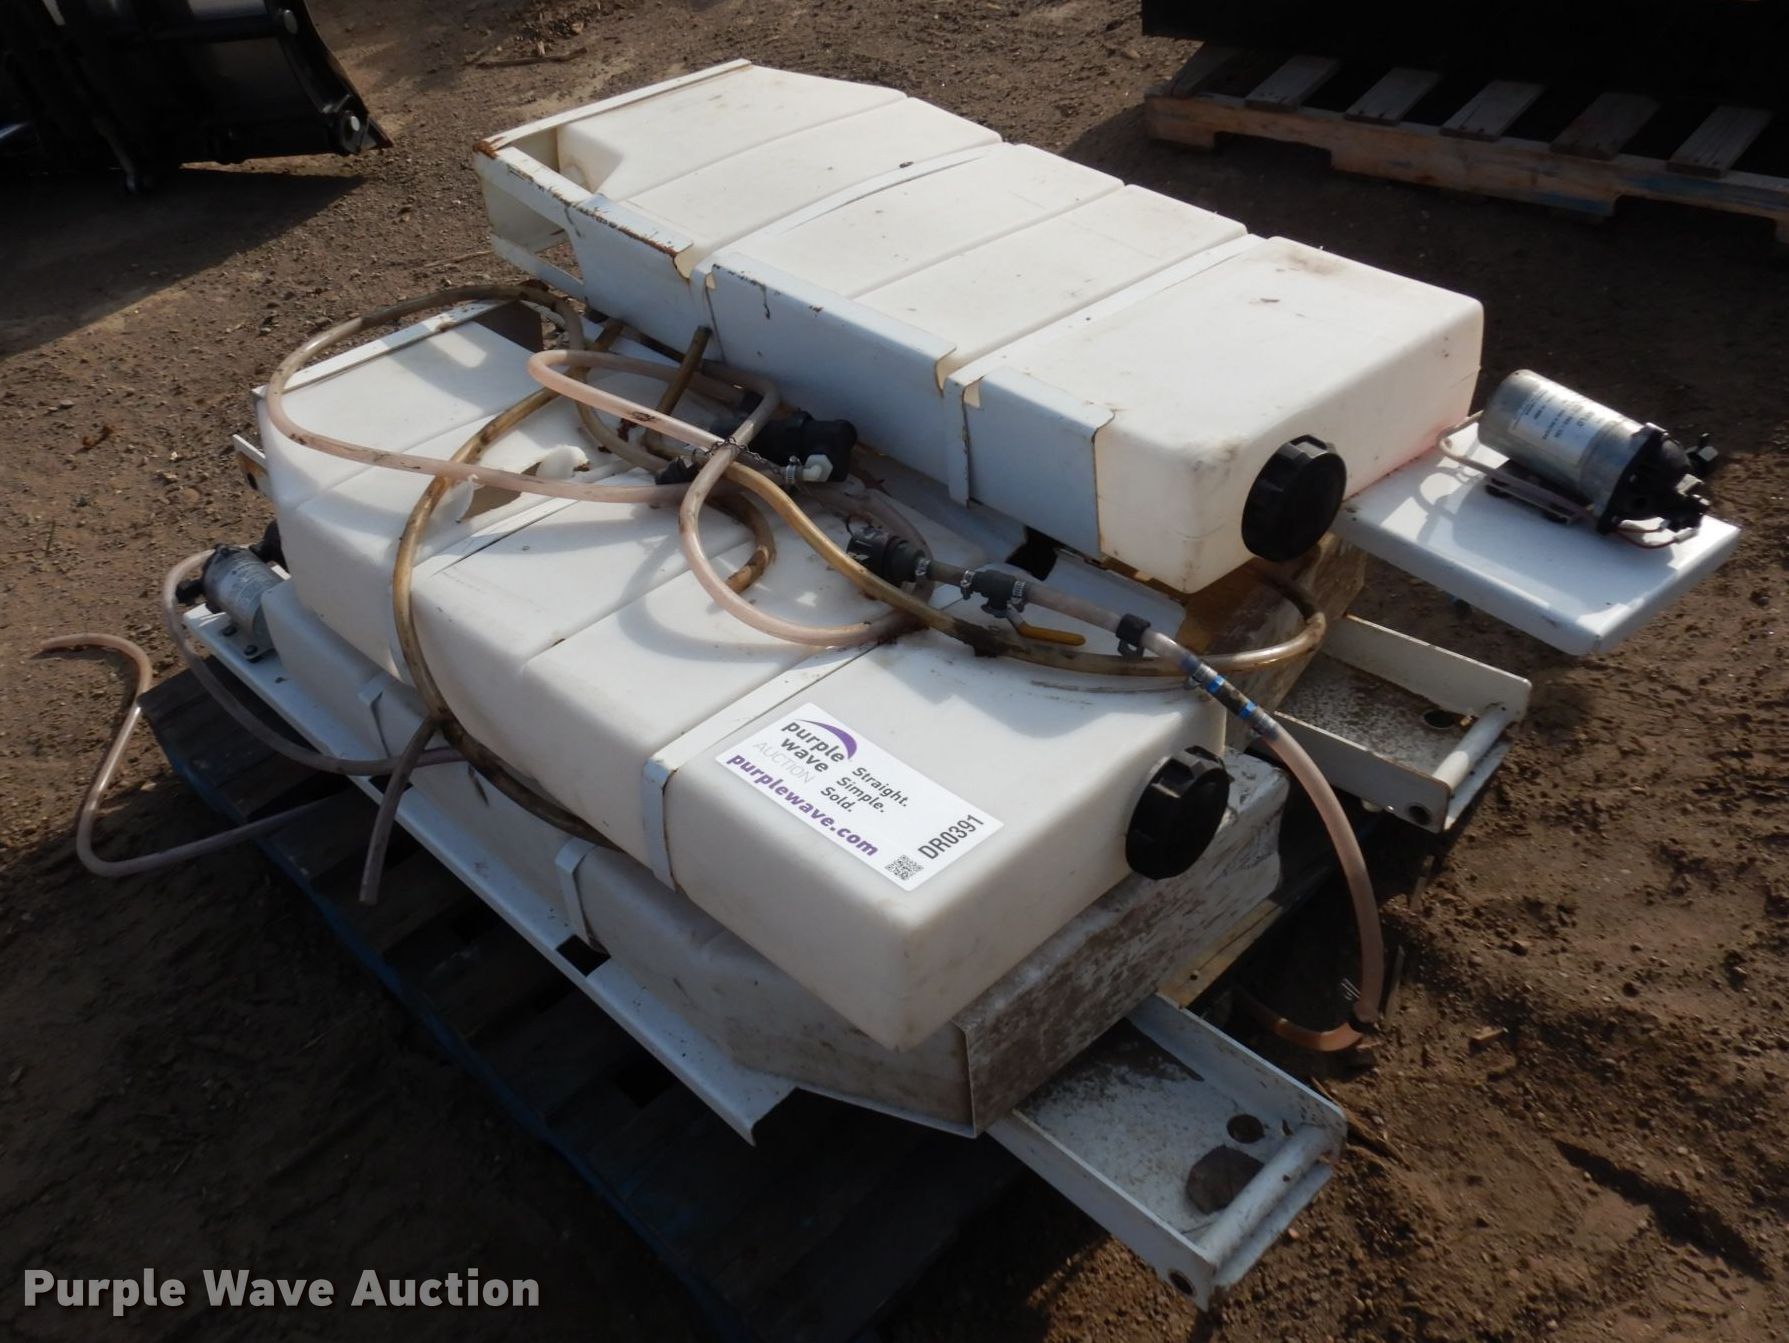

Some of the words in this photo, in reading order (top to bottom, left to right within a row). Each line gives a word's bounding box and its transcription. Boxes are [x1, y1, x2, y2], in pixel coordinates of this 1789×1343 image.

[753, 741, 816, 783] AUCTION
[780, 737, 829, 773] wave
[782, 721, 846, 763] purple
[727, 753, 878, 857] purplewave.com
[821, 787, 852, 813] Sold.
[837, 776, 885, 813] Simple.
[852, 767, 908, 807] Straight.
[918, 814, 985, 860] DR0391
